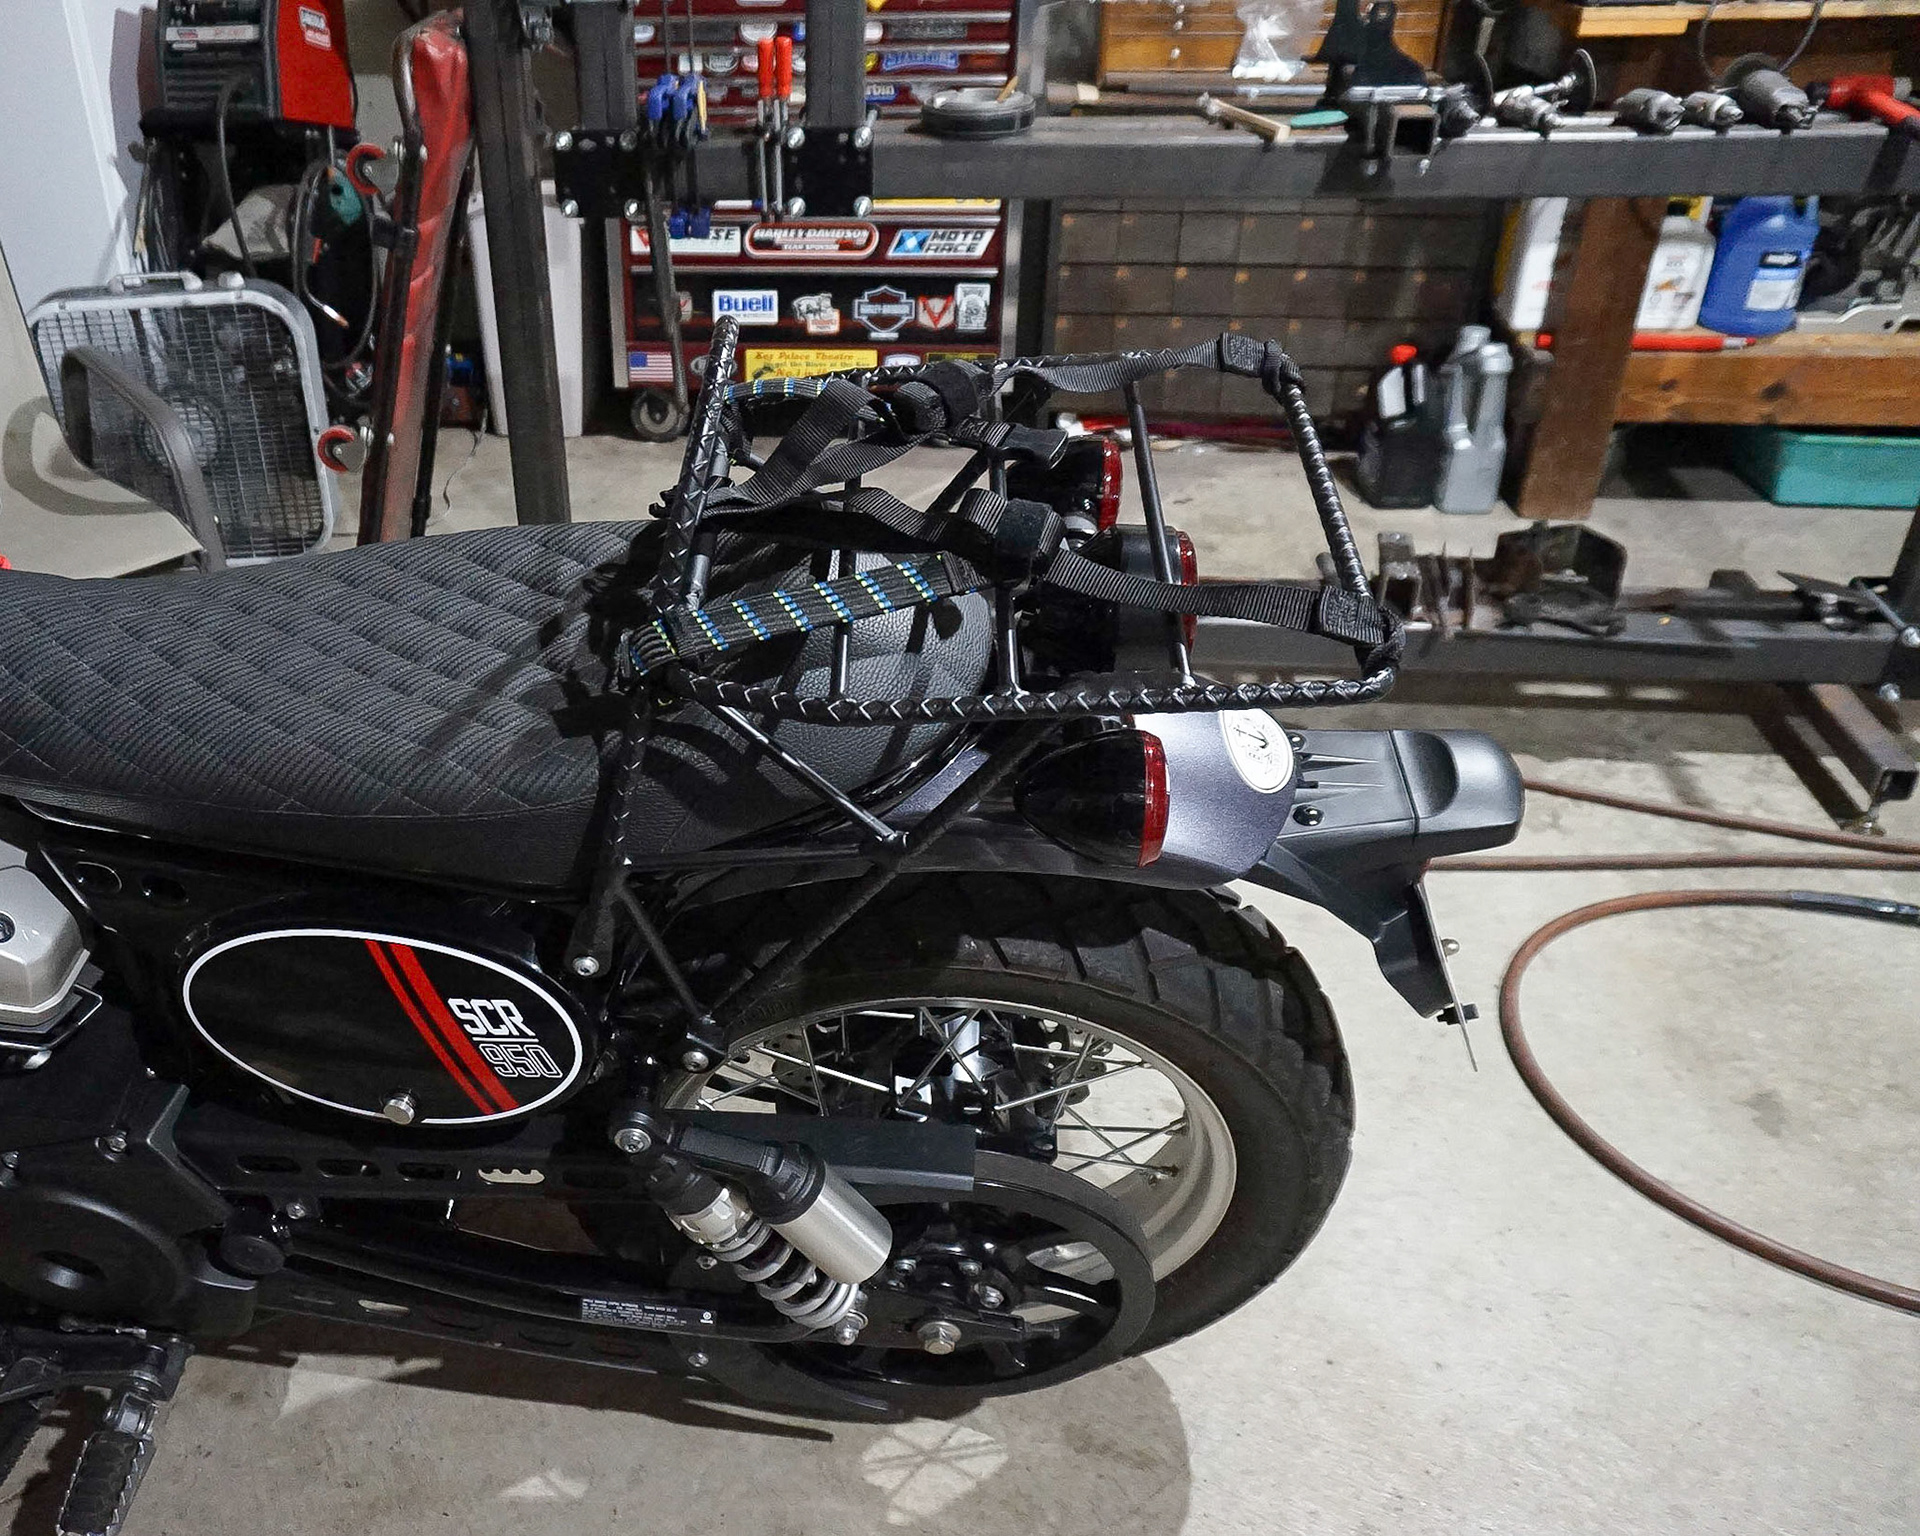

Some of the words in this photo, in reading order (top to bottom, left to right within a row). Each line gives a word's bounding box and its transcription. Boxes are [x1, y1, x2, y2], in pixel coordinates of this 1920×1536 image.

[931, 230, 986, 241] MOTO
[718, 294, 774, 312] Buell
[448, 998, 536, 1036] SCR
[479, 1043, 563, 1077] 950
